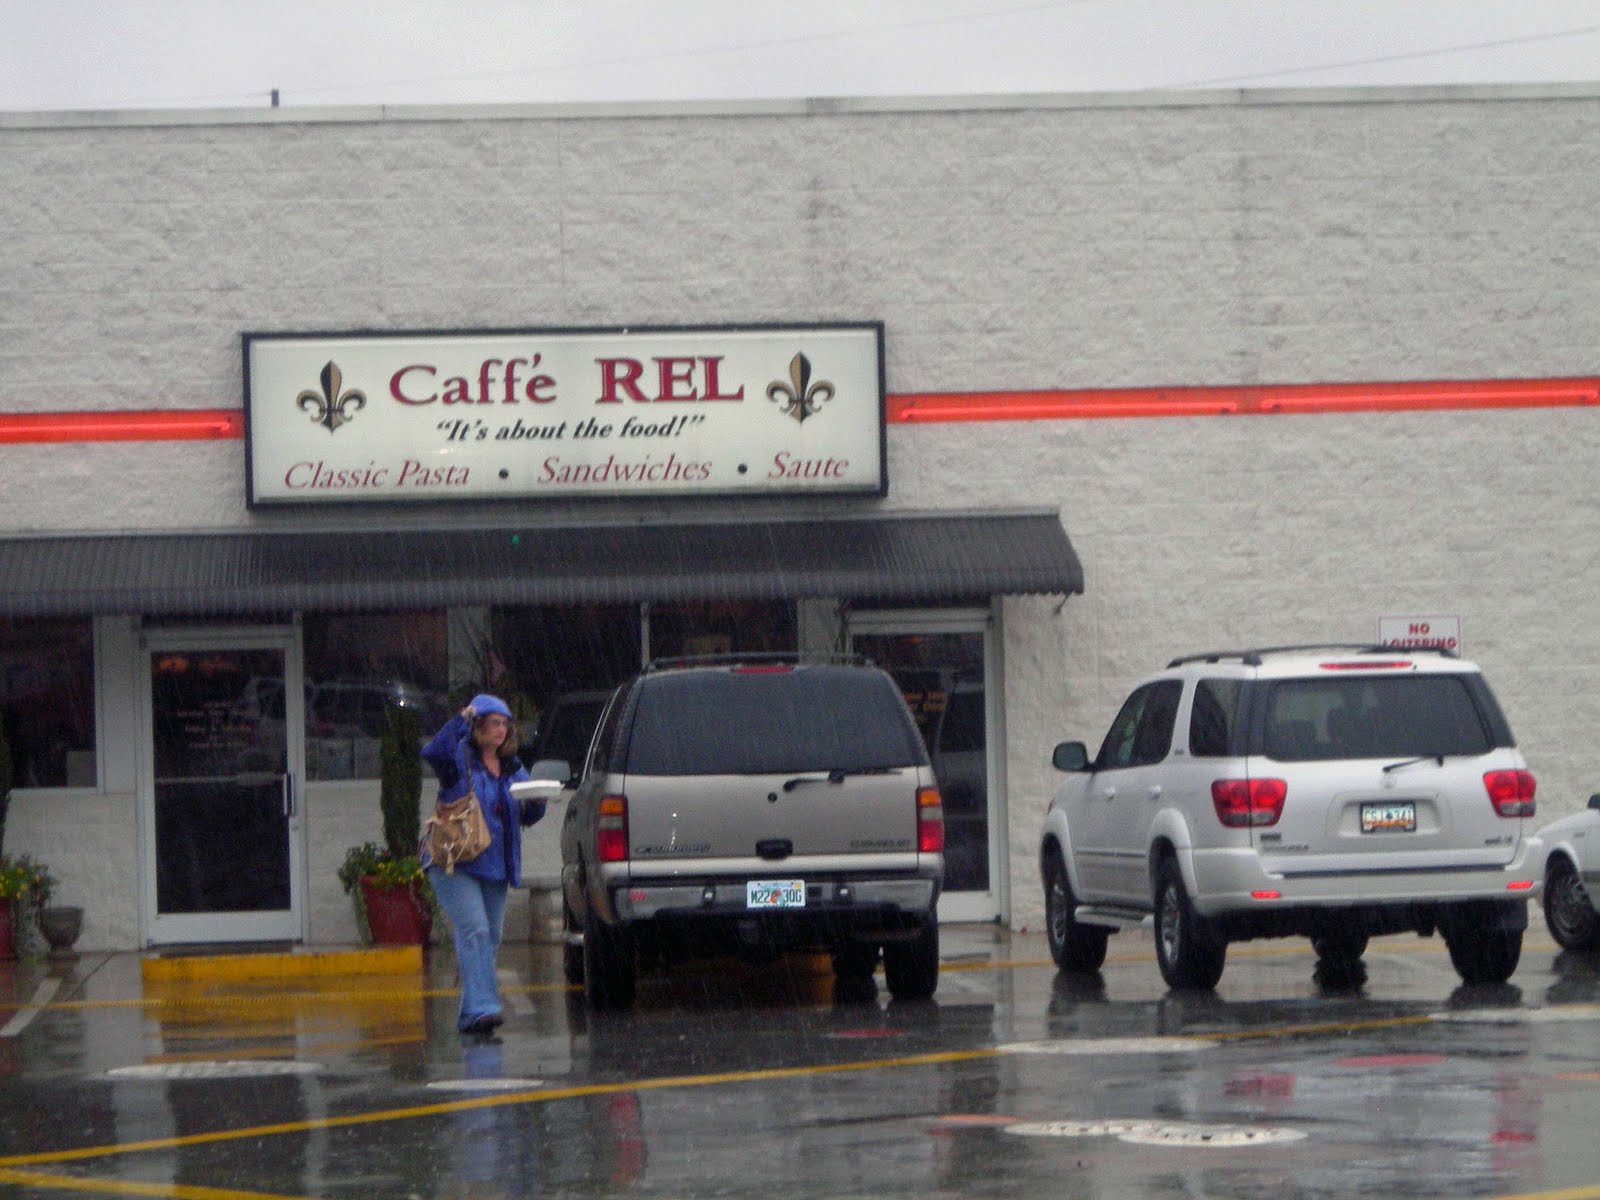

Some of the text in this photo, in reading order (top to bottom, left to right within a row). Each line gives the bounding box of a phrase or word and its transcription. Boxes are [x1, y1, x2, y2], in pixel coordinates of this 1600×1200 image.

[593, 355, 745, 404] REL
[495, 418, 567, 440] about
[573, 416, 614, 440] the
[284, 451, 850, 489] Classic Pasta Sandwiches Saute
[1408, 622, 1430, 635] NO
